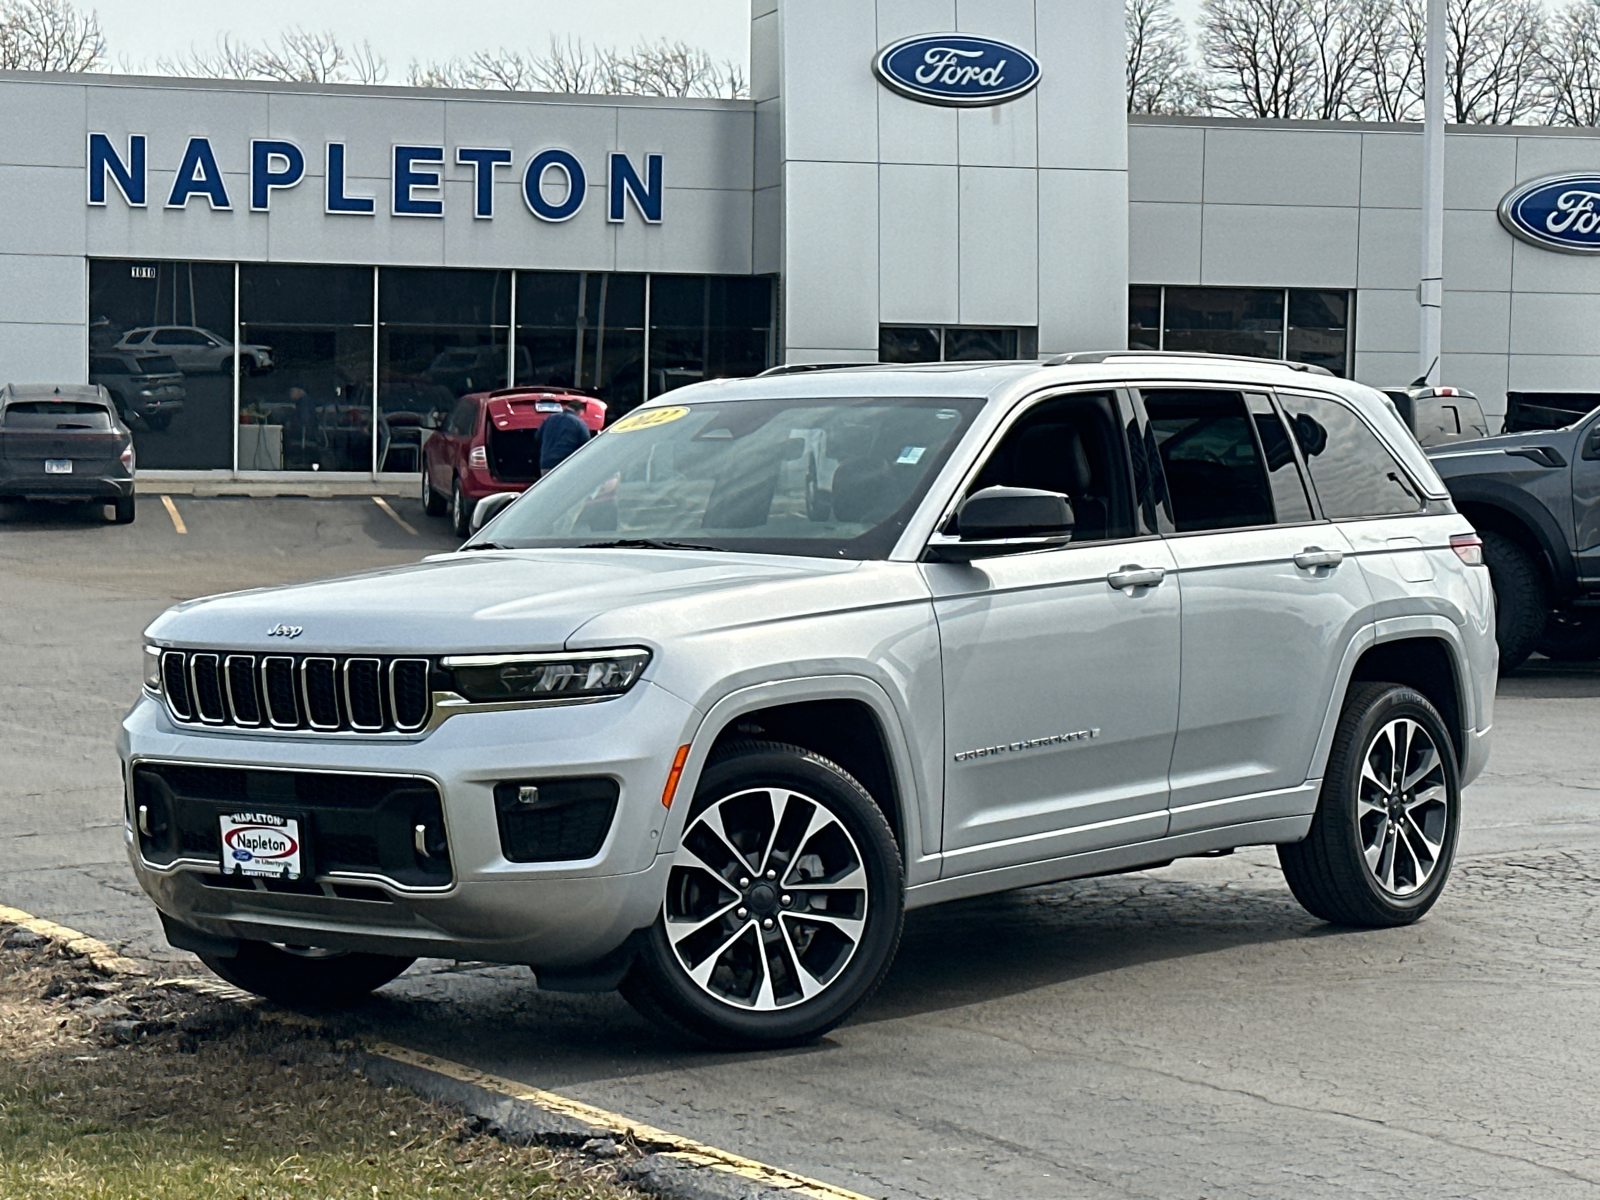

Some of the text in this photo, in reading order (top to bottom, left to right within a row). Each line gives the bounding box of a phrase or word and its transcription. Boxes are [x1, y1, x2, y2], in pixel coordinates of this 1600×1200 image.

[915, 47, 1007, 87] Ford
[86, 132, 664, 224] NAPLETON
[132, 266, 155, 278] 1010
[267, 622, 303, 639] Jeep
[1008, 730, 1088, 752] CHEROKEE
[235, 813, 282, 825] NAPLETON
[237, 833, 286, 852] Napleton
